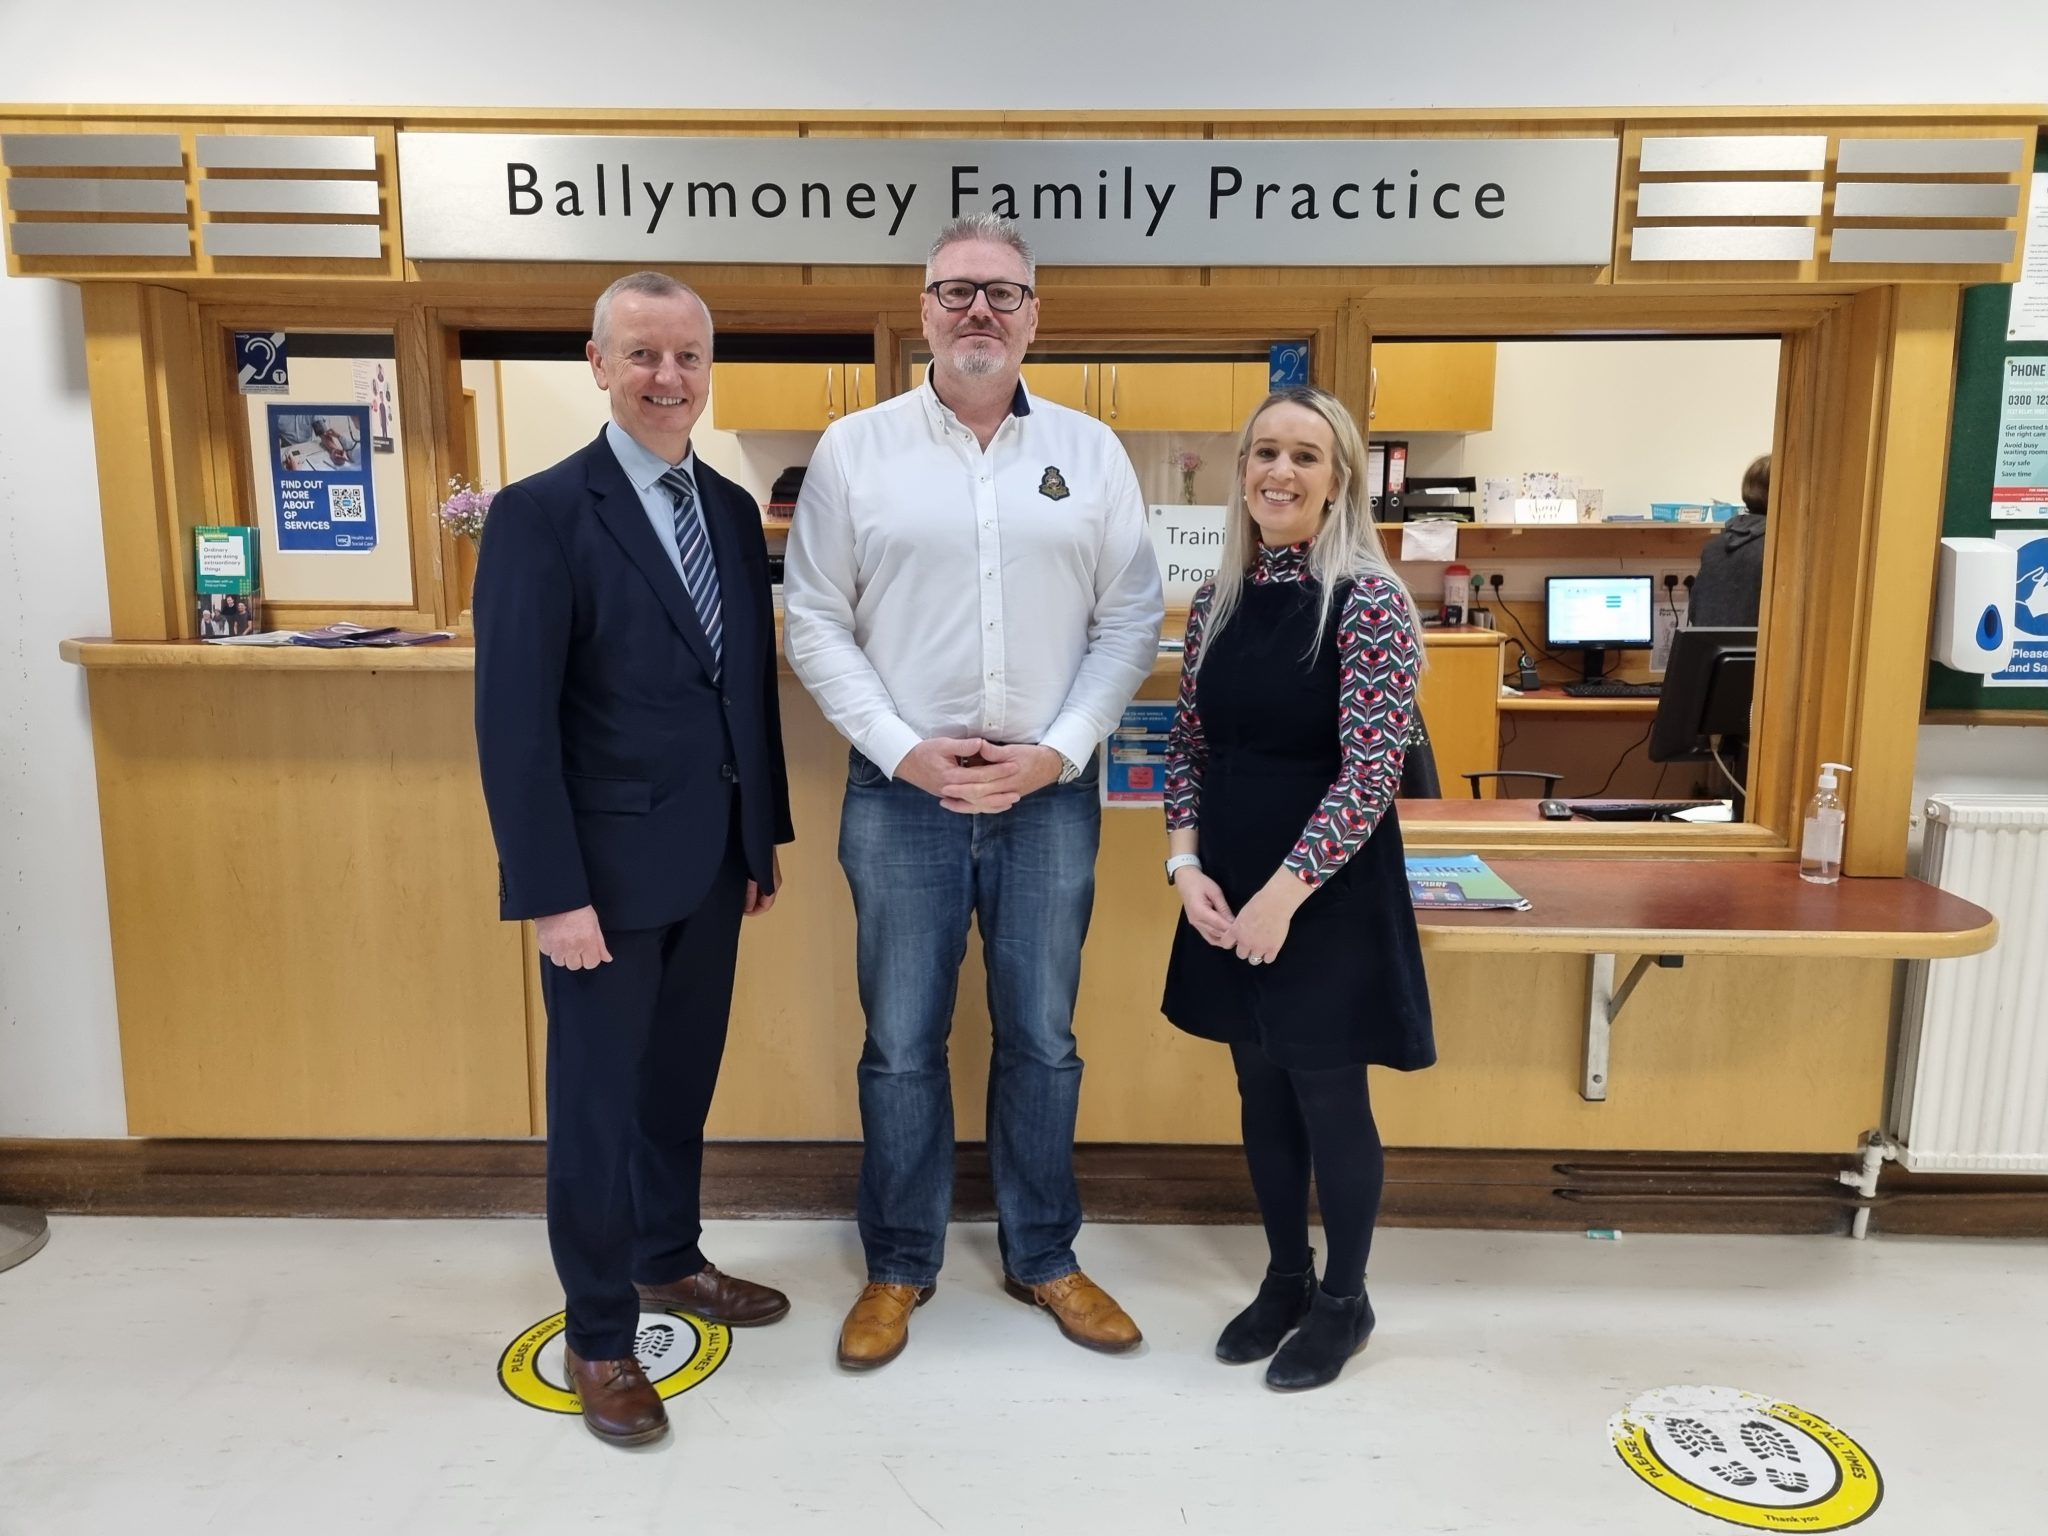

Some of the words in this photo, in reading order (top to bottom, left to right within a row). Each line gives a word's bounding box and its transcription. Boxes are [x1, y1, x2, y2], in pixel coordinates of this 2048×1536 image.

[507, 163, 917, 235] Ballymoney
[952, 166, 1176, 236] Family
[1210, 166, 1505, 219] Practice
[2010, 364, 2046, 377] PHONE
[275, 371, 284, 382] T
[2008, 395, 2032, 405] 0300
[281, 480, 301, 489] FIND
[303, 480, 323, 489] OUT
[282, 490, 309, 499] MORE
[283, 500, 315, 509] ABOUT
[284, 511, 298, 519] GP
[284, 521, 330, 530] SERVICES
[1166, 526, 1226, 545] Traini
[1168, 564, 1216, 583] Prog
[2012, 648, 2048, 659] Please
[2005, 662, 2030, 673] and
[2032, 662, 2048, 673] Sa
[709, 1332, 720, 1346] ALL
[511, 1342, 533, 1373] PLEASE
[527, 1317, 564, 1343] MAINT
[694, 1347, 719, 1371] TIMES
[1624, 1439, 1663, 1478] PLEASE
[1799, 1419, 1822, 1429] AT
[1819, 1431, 1845, 1448] ALL
[1841, 1449, 1867, 1480] TIMES
[1763, 1514, 1799, 1523] Thank
[1802, 1515, 1820, 1523] you
